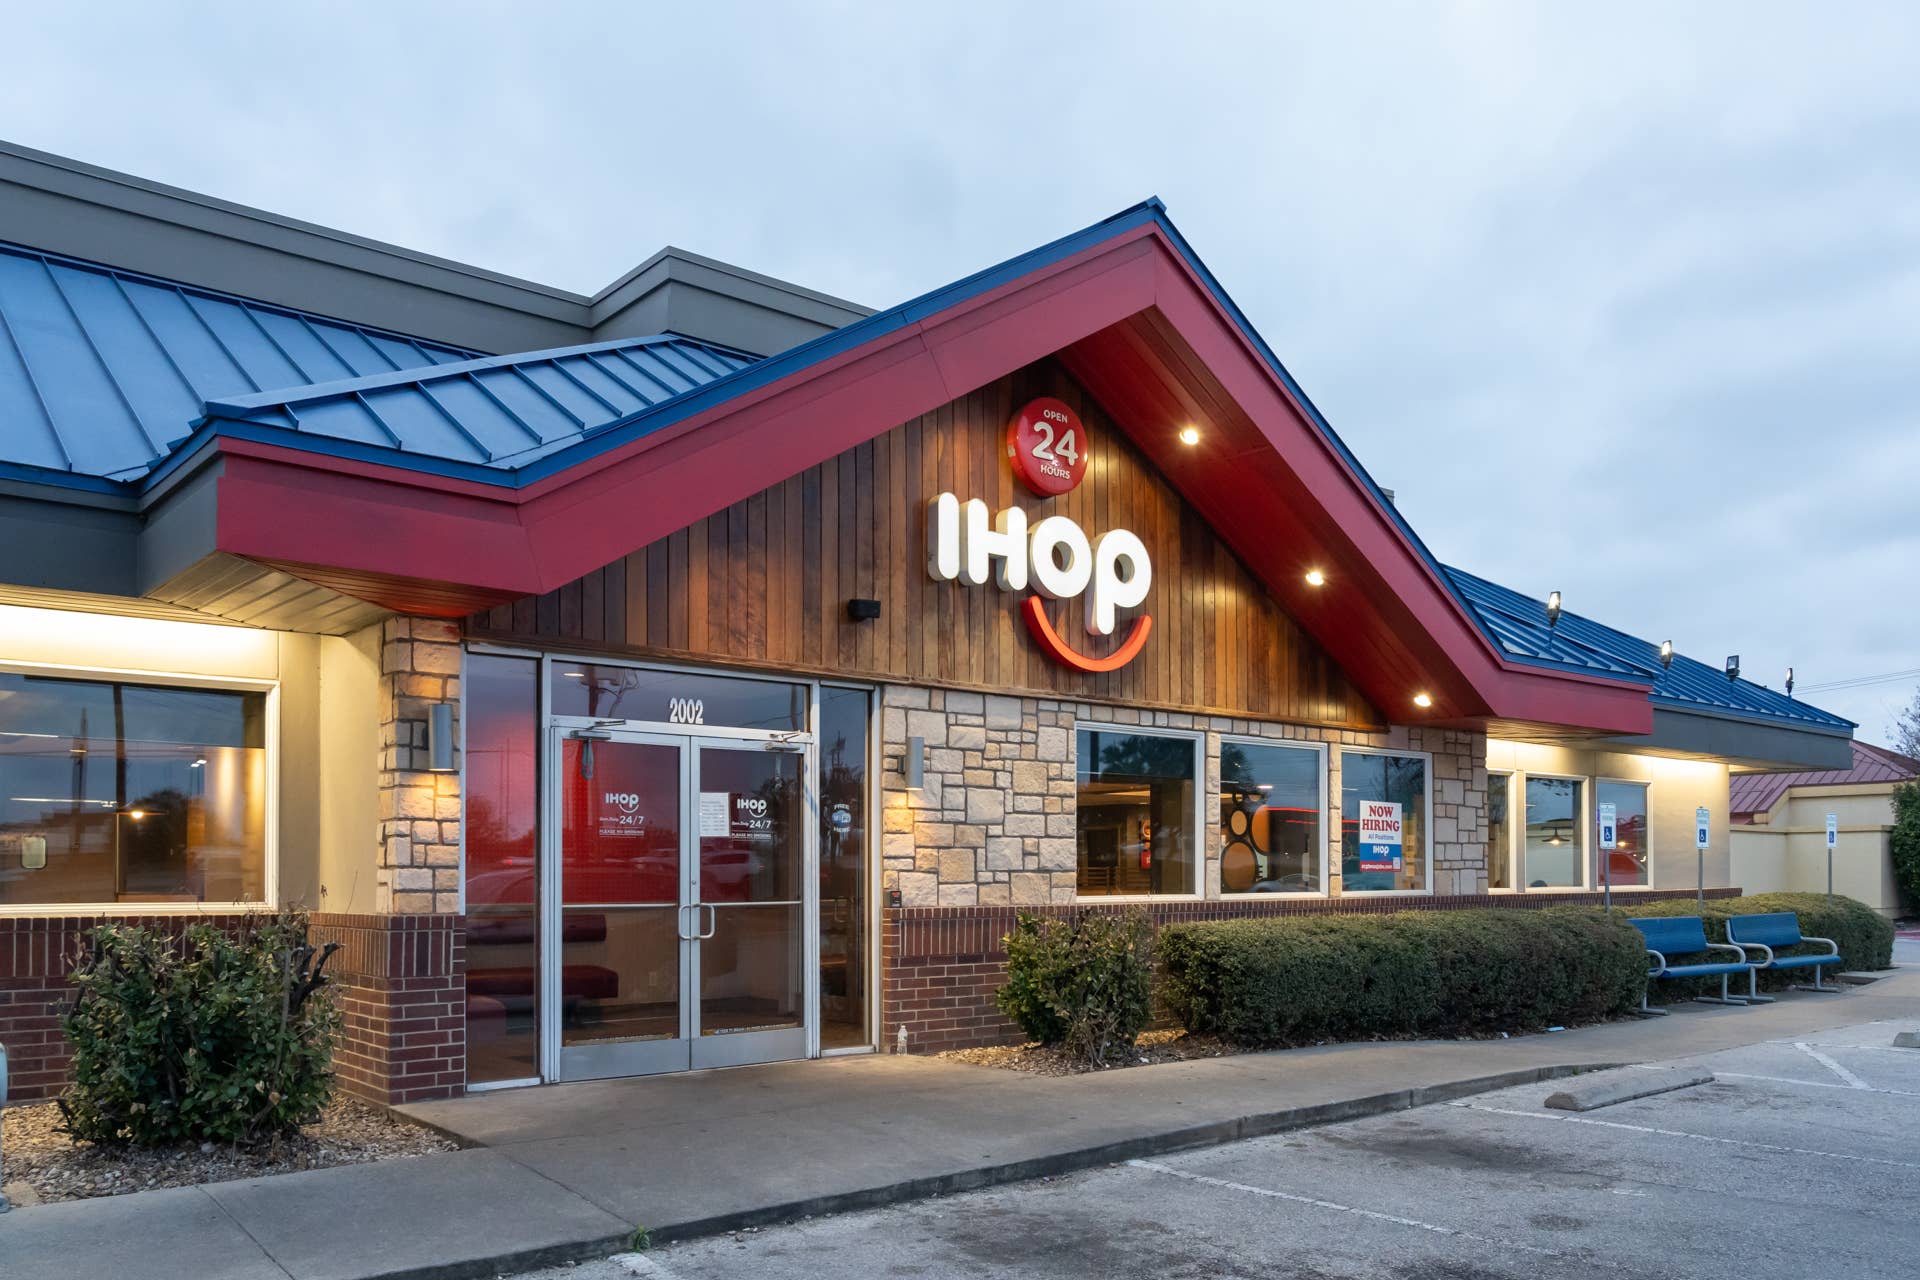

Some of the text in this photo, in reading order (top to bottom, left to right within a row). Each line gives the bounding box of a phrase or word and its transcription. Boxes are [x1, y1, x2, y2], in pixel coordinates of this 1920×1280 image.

[1043, 409, 1068, 424] OPEN
[1032, 421, 1078, 466] 24
[1040, 464, 1070, 480] HOURS
[669, 697, 704, 725] 2002
[1369, 805, 1394, 818] NOW
[619, 815, 645, 825] 24/7
[749, 819, 772, 829] 24/7
[1361, 819, 1400, 832] HIRING
